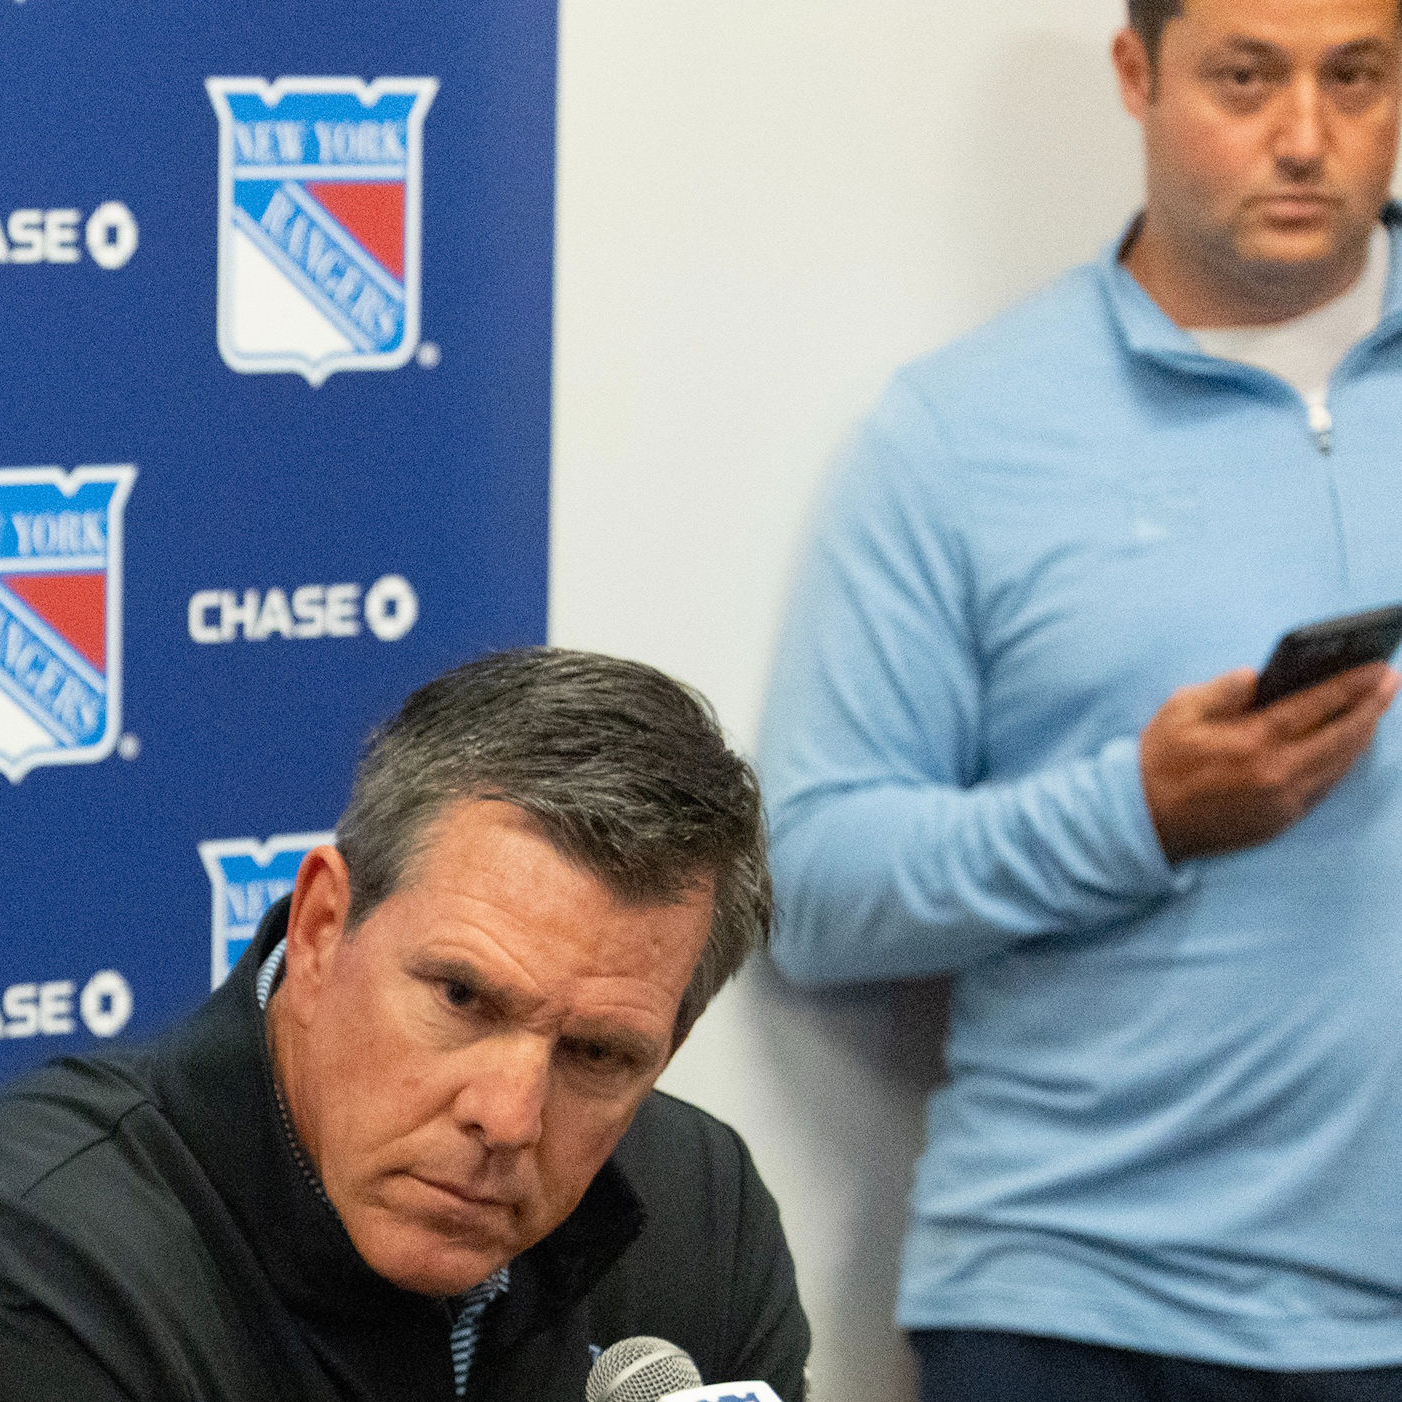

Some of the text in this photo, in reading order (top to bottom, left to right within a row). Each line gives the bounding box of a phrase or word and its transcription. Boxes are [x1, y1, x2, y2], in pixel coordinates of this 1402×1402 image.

[231, 122, 307, 164] NEW
[12, 511, 107, 557] YORK
[188, 584, 359, 642] CHASE
